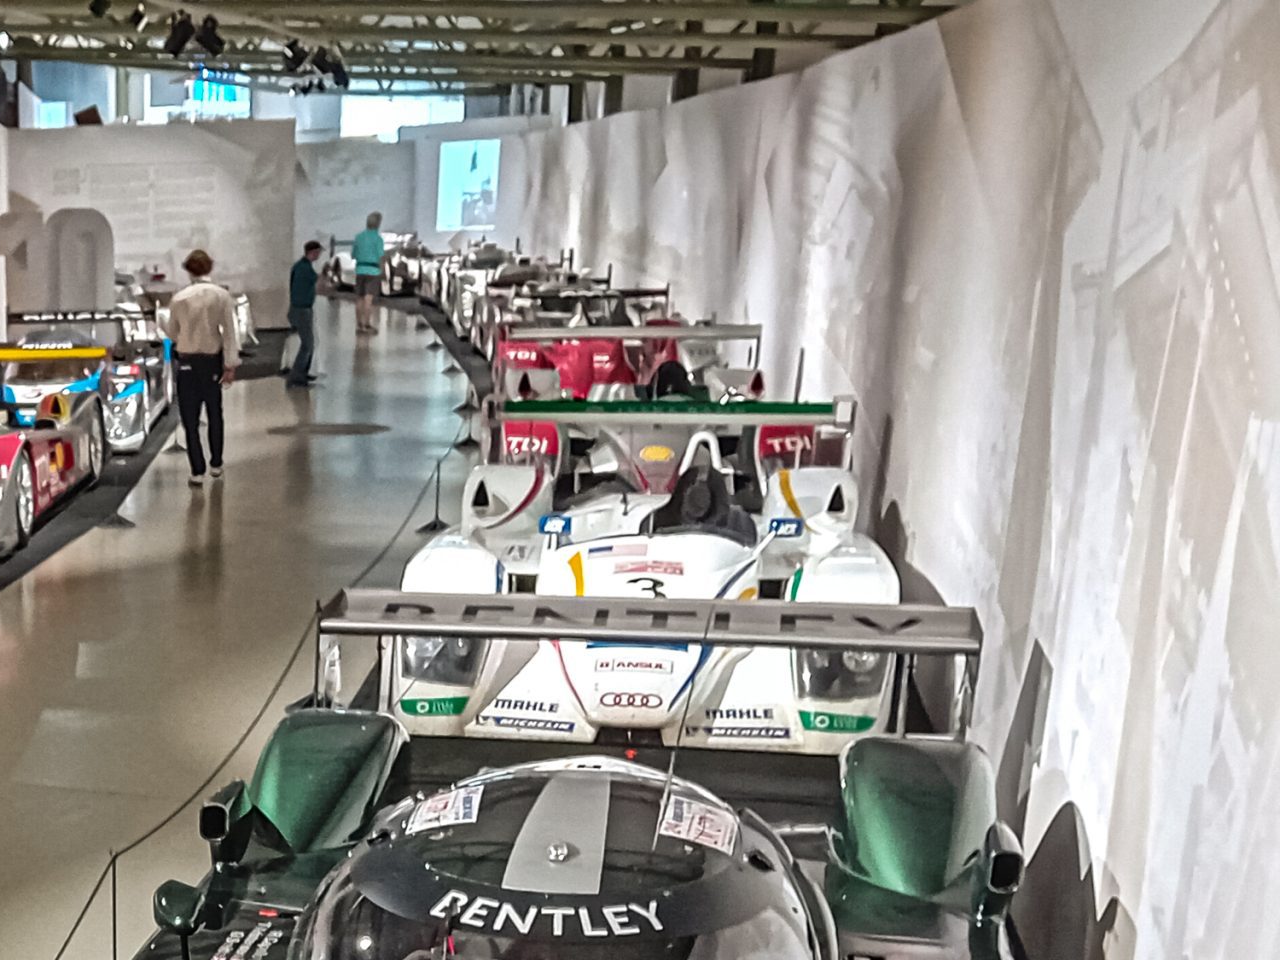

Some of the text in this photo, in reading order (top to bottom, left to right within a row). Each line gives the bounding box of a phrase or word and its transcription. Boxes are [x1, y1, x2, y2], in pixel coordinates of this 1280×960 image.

[507, 436, 548, 454] TDI
[766, 434, 812, 453] TDI
[626, 577, 667, 599] 3
[494, 699, 559, 713] MAHLE
[706, 708, 774, 720] MAHLE
[499, 718, 570, 730] MICHELIN
[711, 727, 786, 737] MICHELIN
[429, 889, 663, 936] BENTLEY
